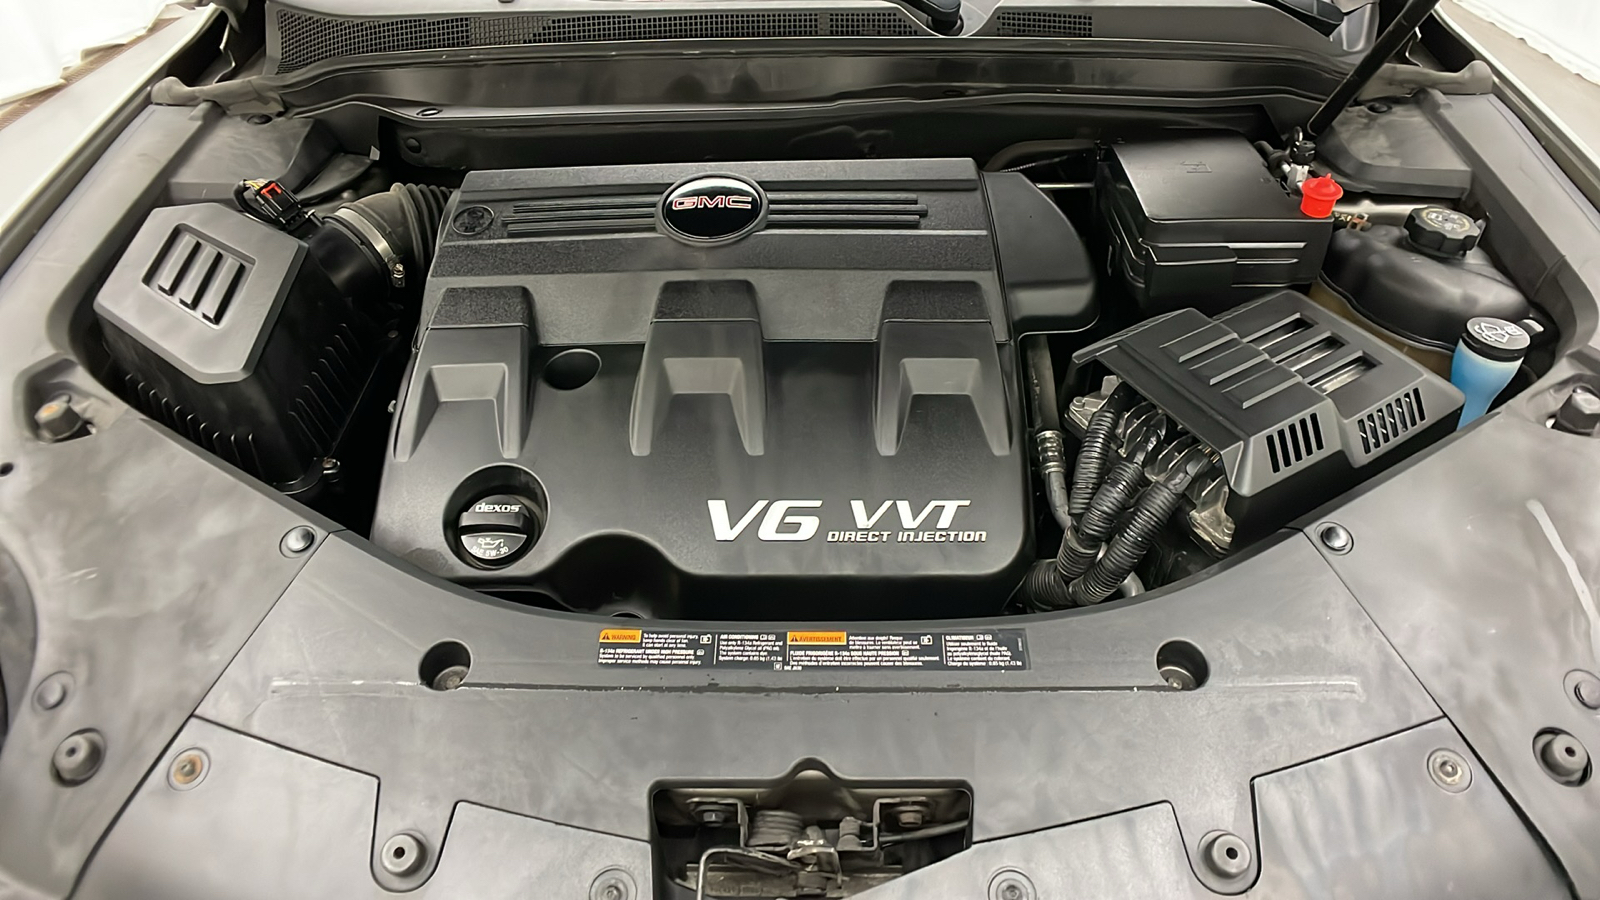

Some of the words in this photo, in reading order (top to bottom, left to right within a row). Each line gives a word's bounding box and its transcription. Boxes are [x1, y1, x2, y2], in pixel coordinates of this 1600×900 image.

[672, 196, 752, 210] GMC
[475, 502, 522, 512] dexos
[707, 499, 823, 542] V6
[850, 499, 972, 530] VVT
[826, 531, 892, 542] DIRECT
[896, 531, 987, 542] INJECTION
